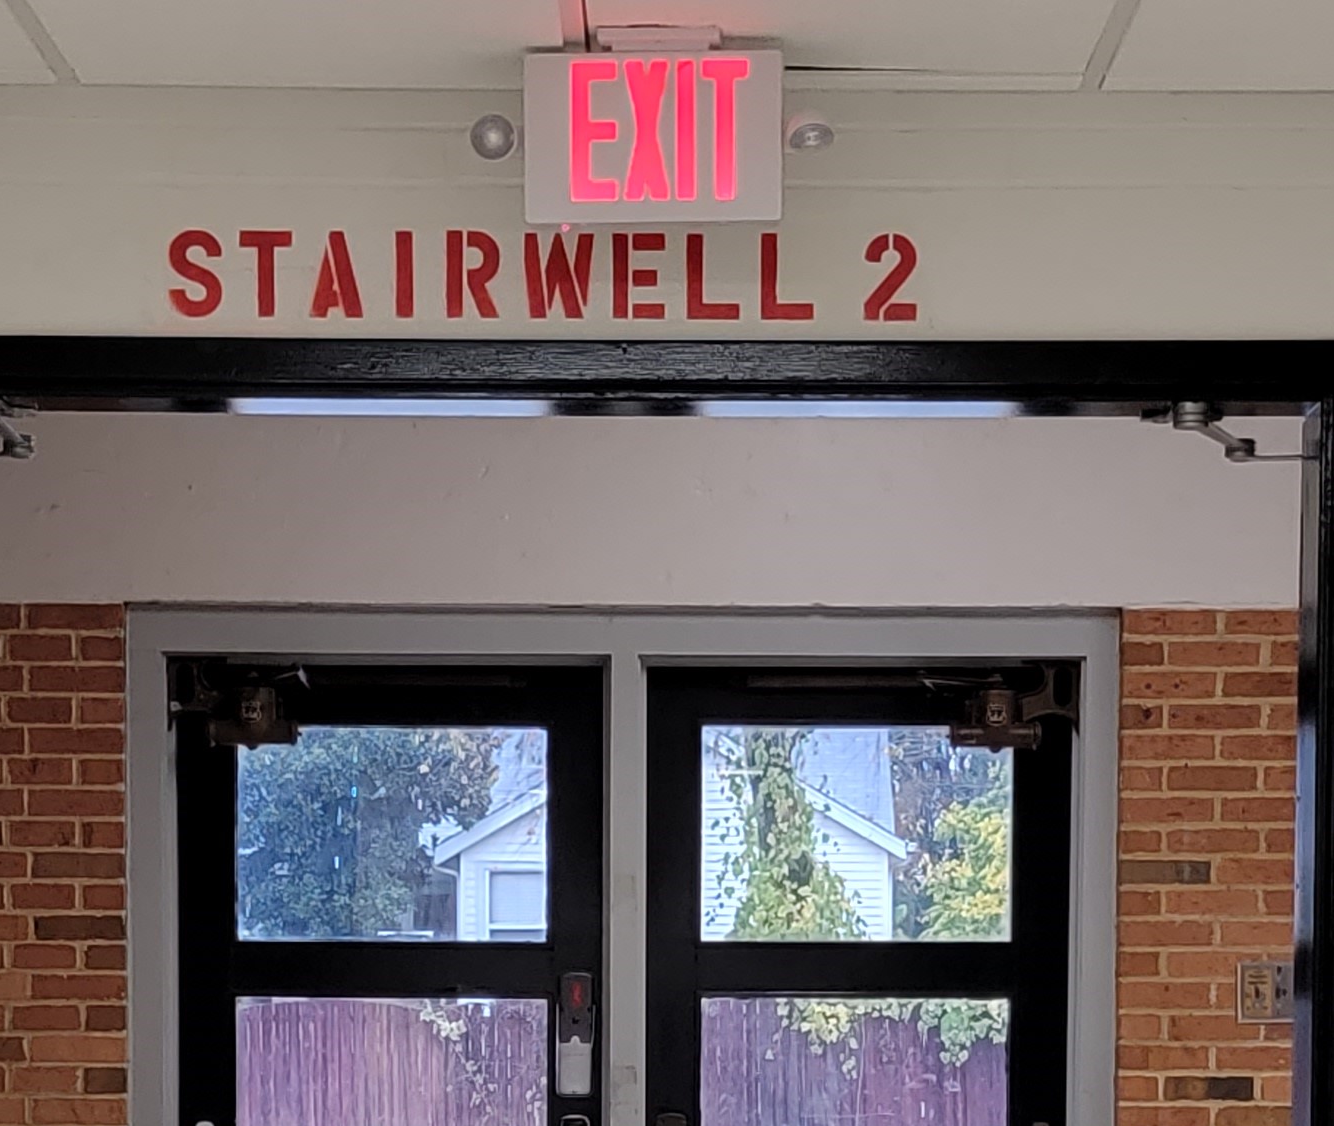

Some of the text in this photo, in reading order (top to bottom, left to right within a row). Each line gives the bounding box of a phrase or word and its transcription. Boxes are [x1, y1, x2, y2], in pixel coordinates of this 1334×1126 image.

[569, 57, 751, 203] EXIT
[168, 229, 918, 321] STAIRWELL 2
